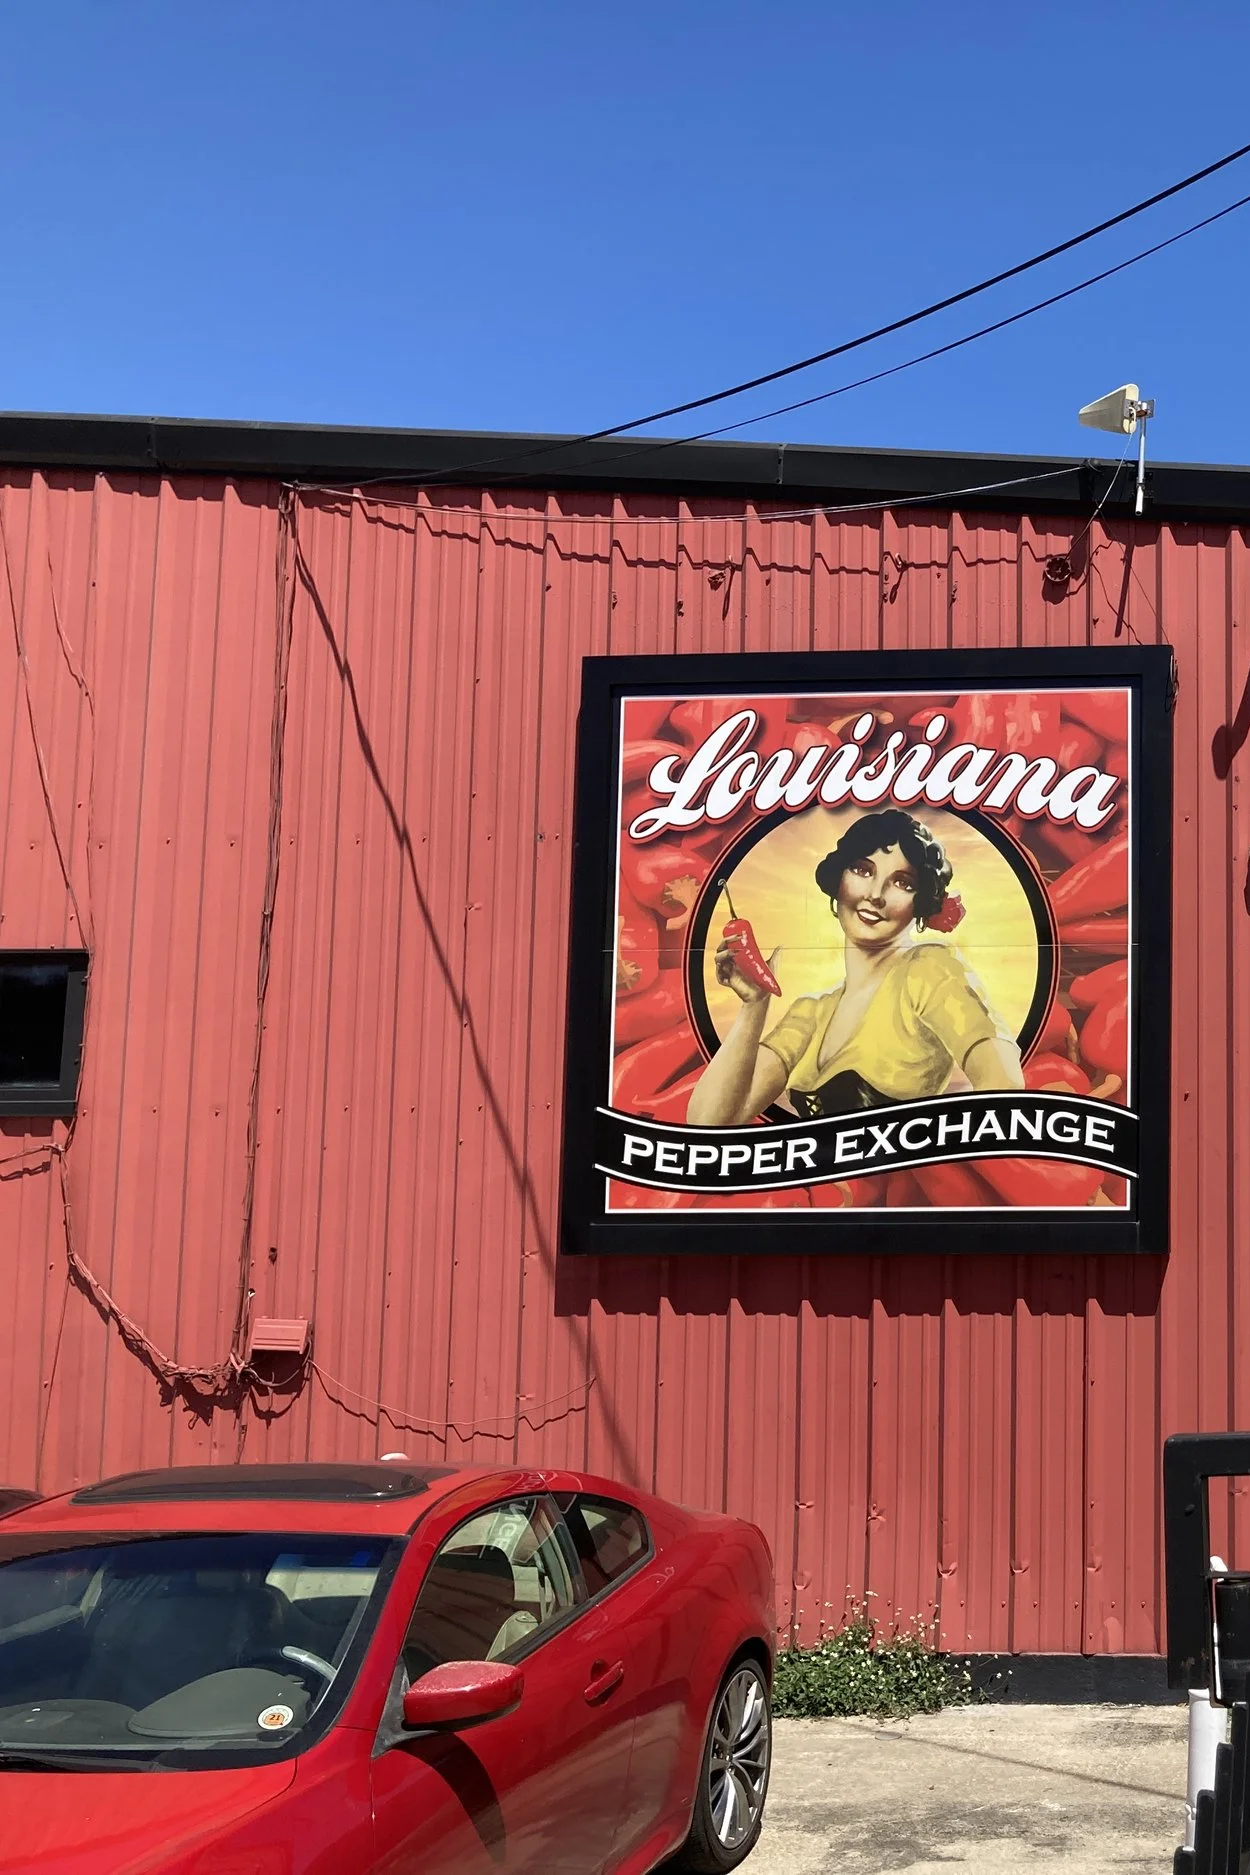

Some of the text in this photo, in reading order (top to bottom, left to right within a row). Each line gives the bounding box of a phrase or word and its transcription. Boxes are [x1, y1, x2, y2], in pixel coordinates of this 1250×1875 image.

[628, 708, 1121, 840] Louisiana
[621, 1108, 1117, 1177] PEPPER EXCHANGE
